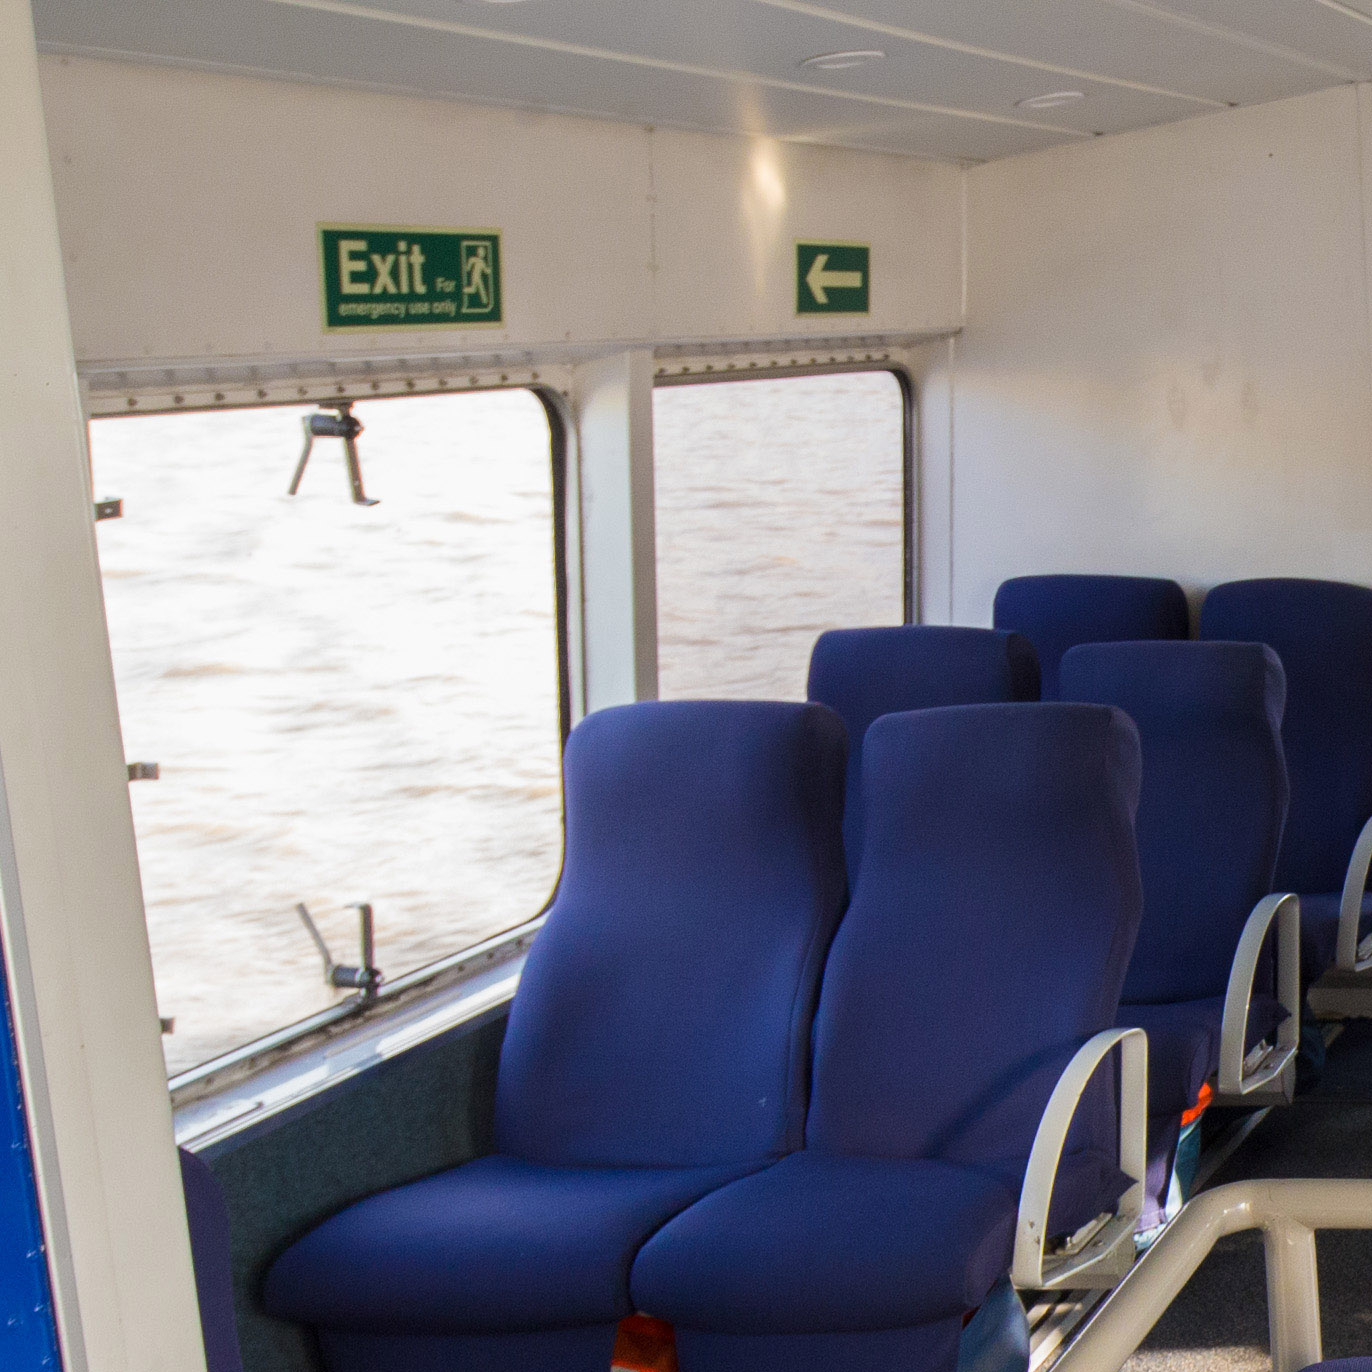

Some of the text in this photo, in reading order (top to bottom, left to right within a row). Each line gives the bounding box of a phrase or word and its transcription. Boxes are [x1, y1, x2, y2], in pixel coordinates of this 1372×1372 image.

[338, 239, 456, 295] Exit For
[338, 299, 457, 319] emergency use only
